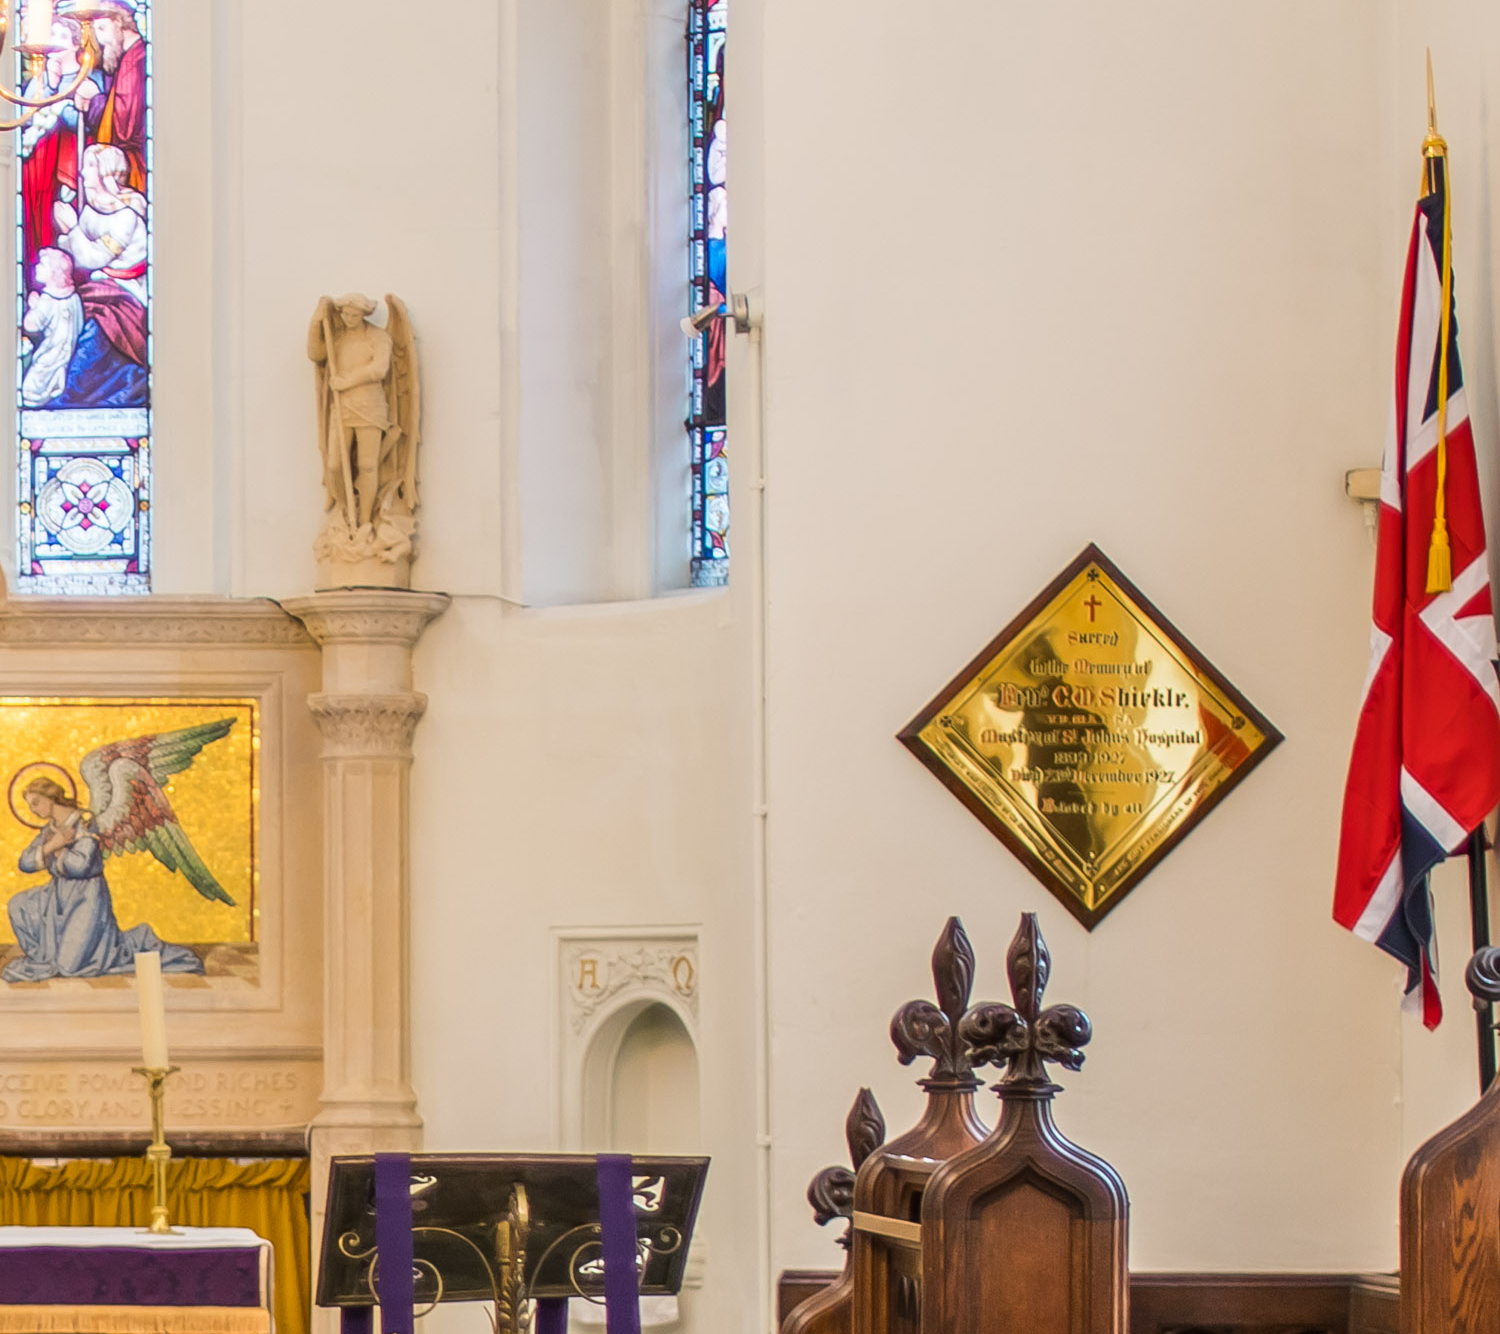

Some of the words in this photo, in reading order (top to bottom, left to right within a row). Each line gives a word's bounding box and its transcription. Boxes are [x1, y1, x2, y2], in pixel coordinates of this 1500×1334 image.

[1133, 728, 1201, 749] Hospital
[98, 1100, 145, 1118] AND
[164, 1098, 264, 1118] LESSING
